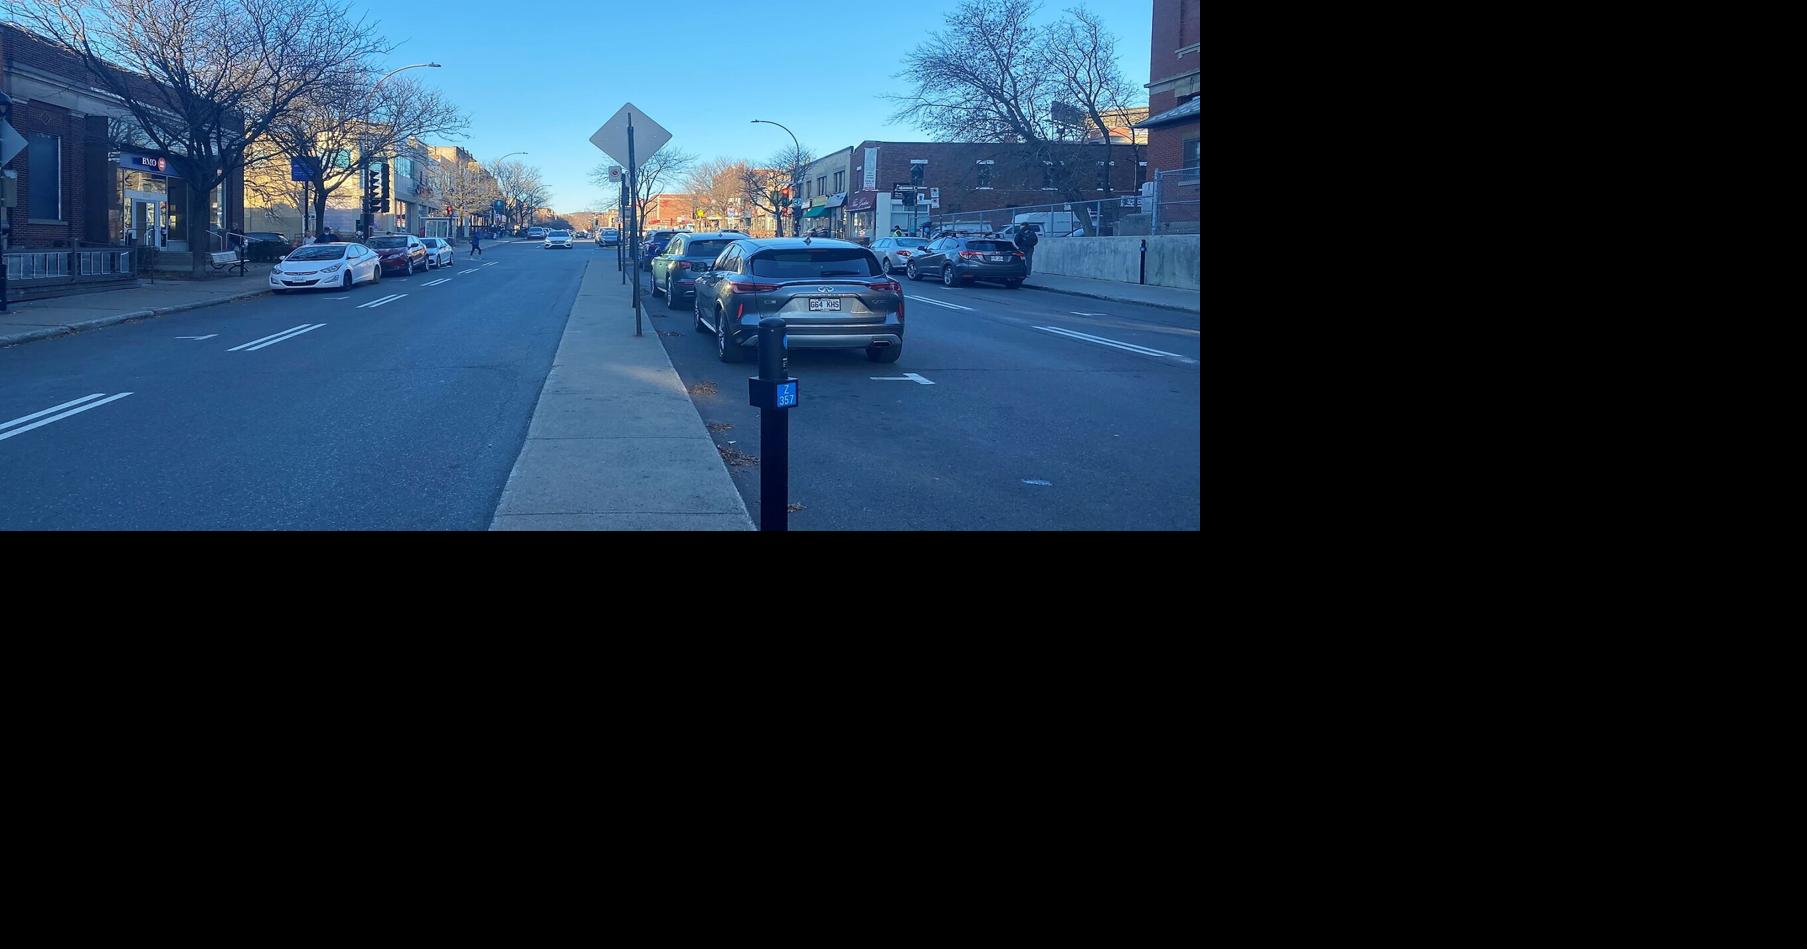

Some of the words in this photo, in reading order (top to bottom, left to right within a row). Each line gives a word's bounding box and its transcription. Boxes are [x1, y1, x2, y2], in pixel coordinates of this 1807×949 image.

[142, 157, 157, 167] BMO
[810, 300, 823, 308] G64
[826, 300, 839, 308] KHS
[783, 384, 790, 394] Z
[779, 394, 794, 406] 357
